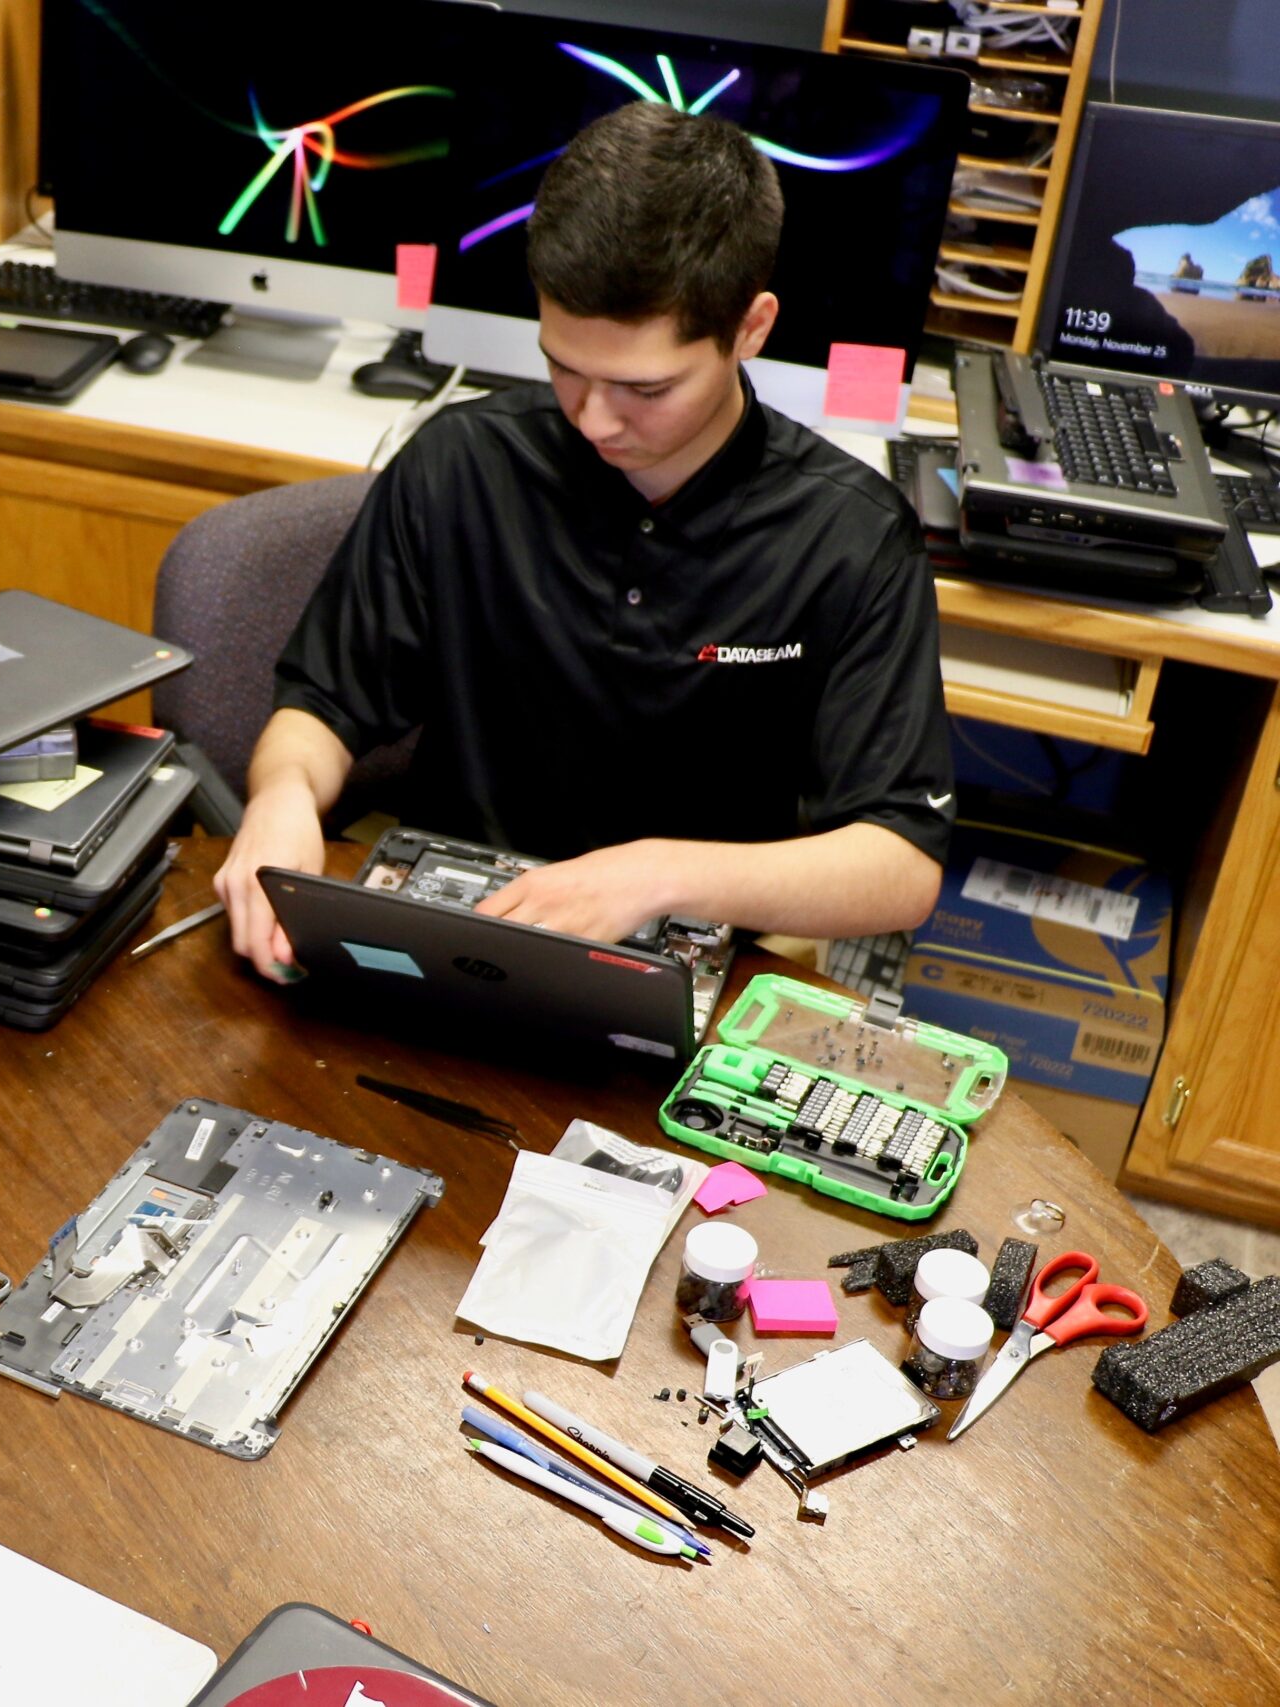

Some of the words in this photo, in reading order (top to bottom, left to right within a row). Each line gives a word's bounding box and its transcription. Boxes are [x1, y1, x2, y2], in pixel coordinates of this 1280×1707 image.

[1065, 306, 1112, 333] 11:39
[1059, 332, 1099, 349] Monday,
[1102, 338, 1152, 356] November
[1153, 345, 1167, 358] 25
[717, 643, 801, 663] DATASEAM
[1082, 1000, 1150, 1029] 720222
